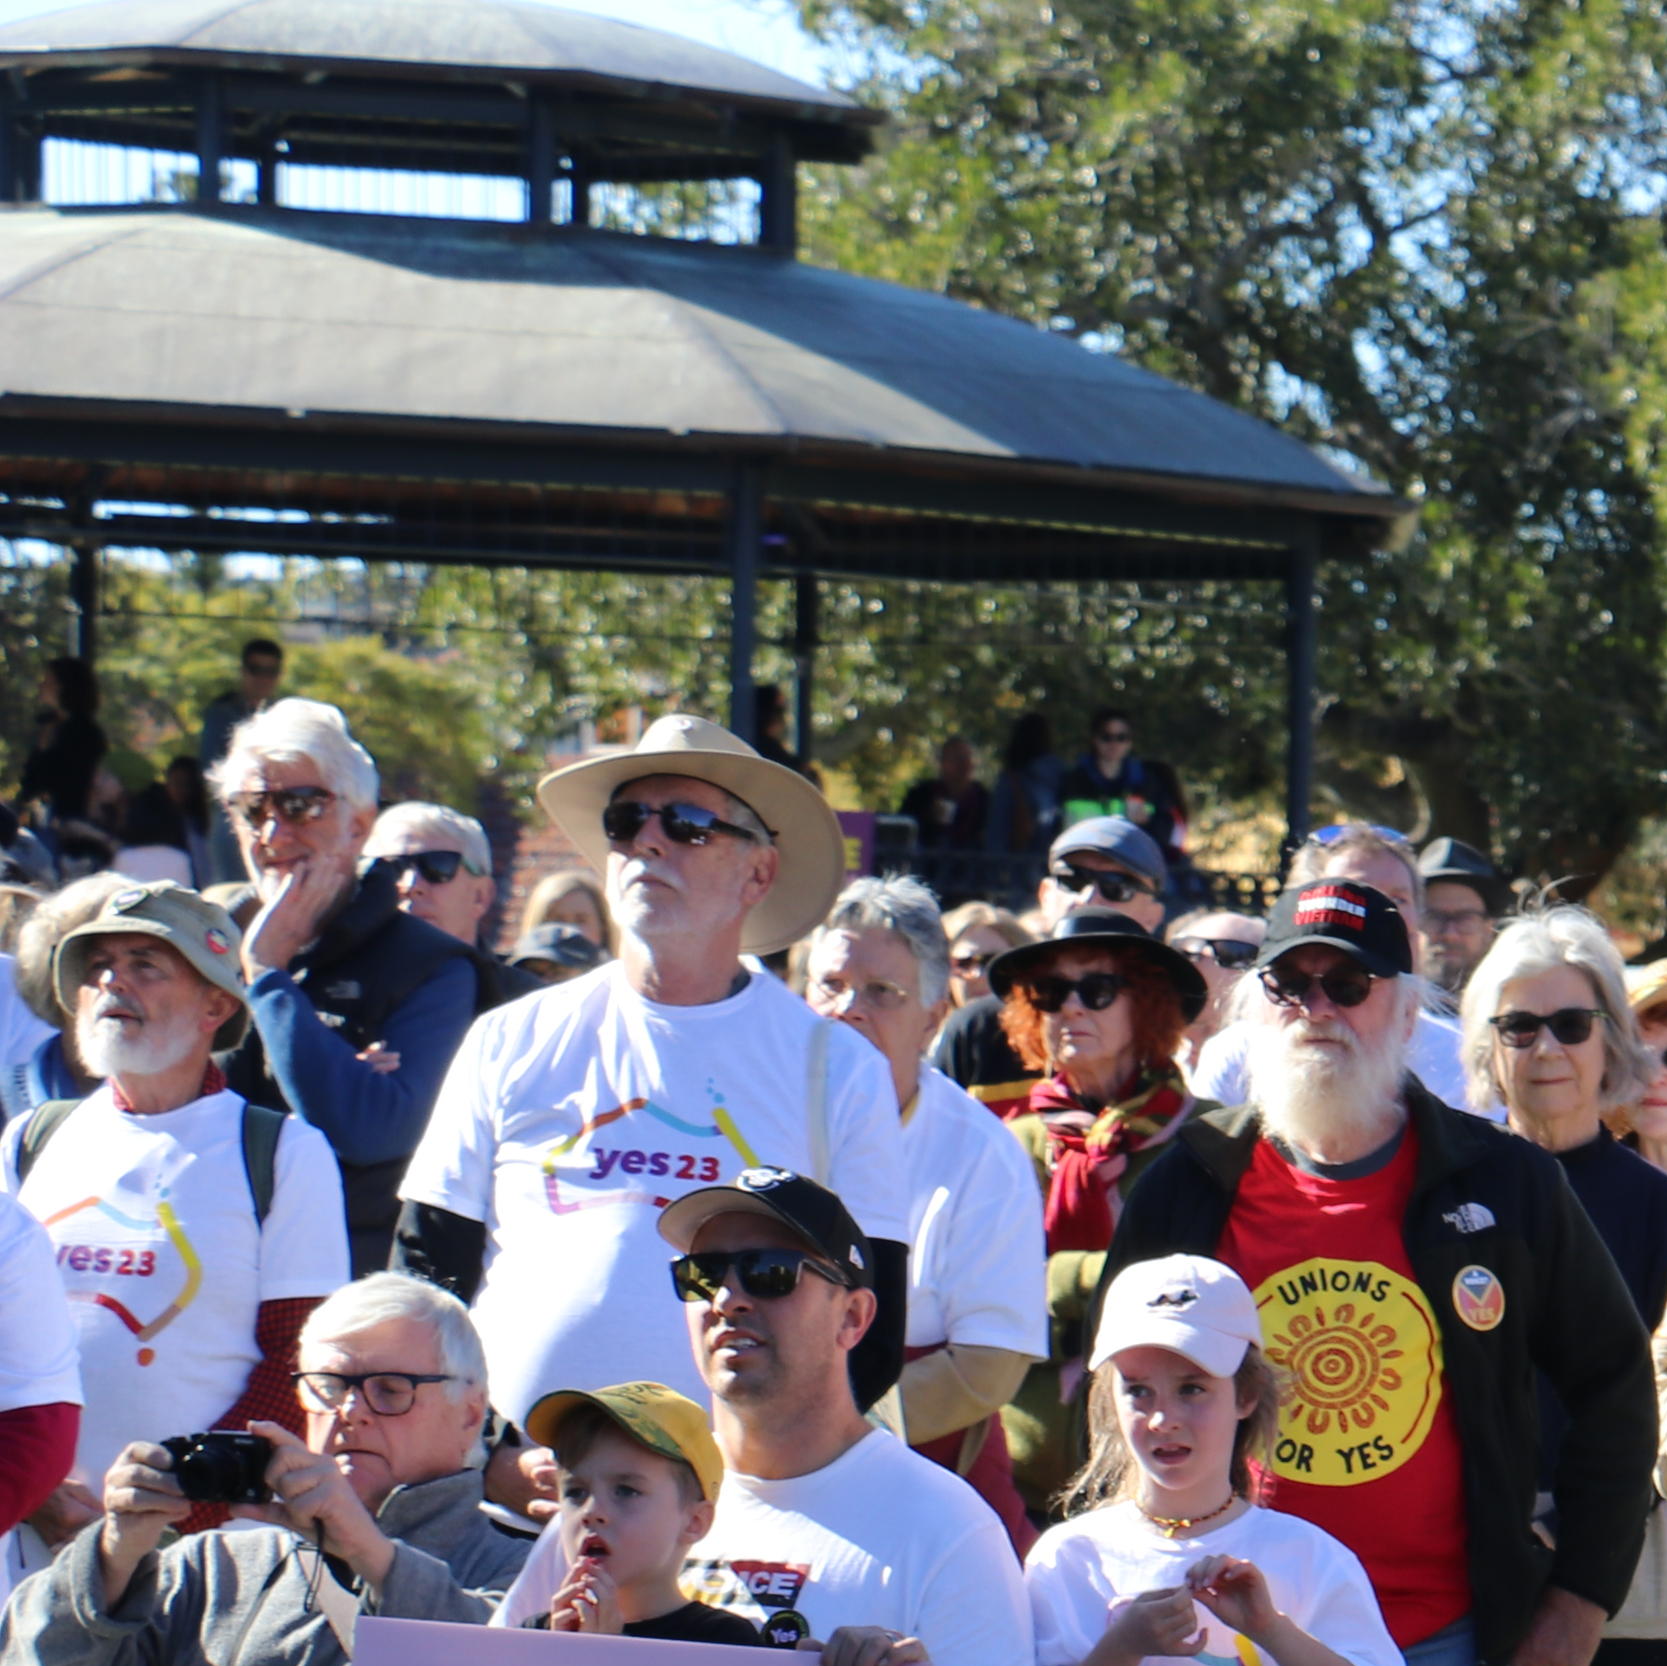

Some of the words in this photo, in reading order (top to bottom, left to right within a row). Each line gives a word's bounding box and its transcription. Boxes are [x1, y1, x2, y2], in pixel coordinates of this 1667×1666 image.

[588, 1147, 720, 1183] yes23
[1277, 1268, 1392, 1306] UNIONS
[1275, 1433, 1315, 1473] OR
[1335, 1434, 1394, 1474] YES
[770, 1628, 798, 1644] Yes
